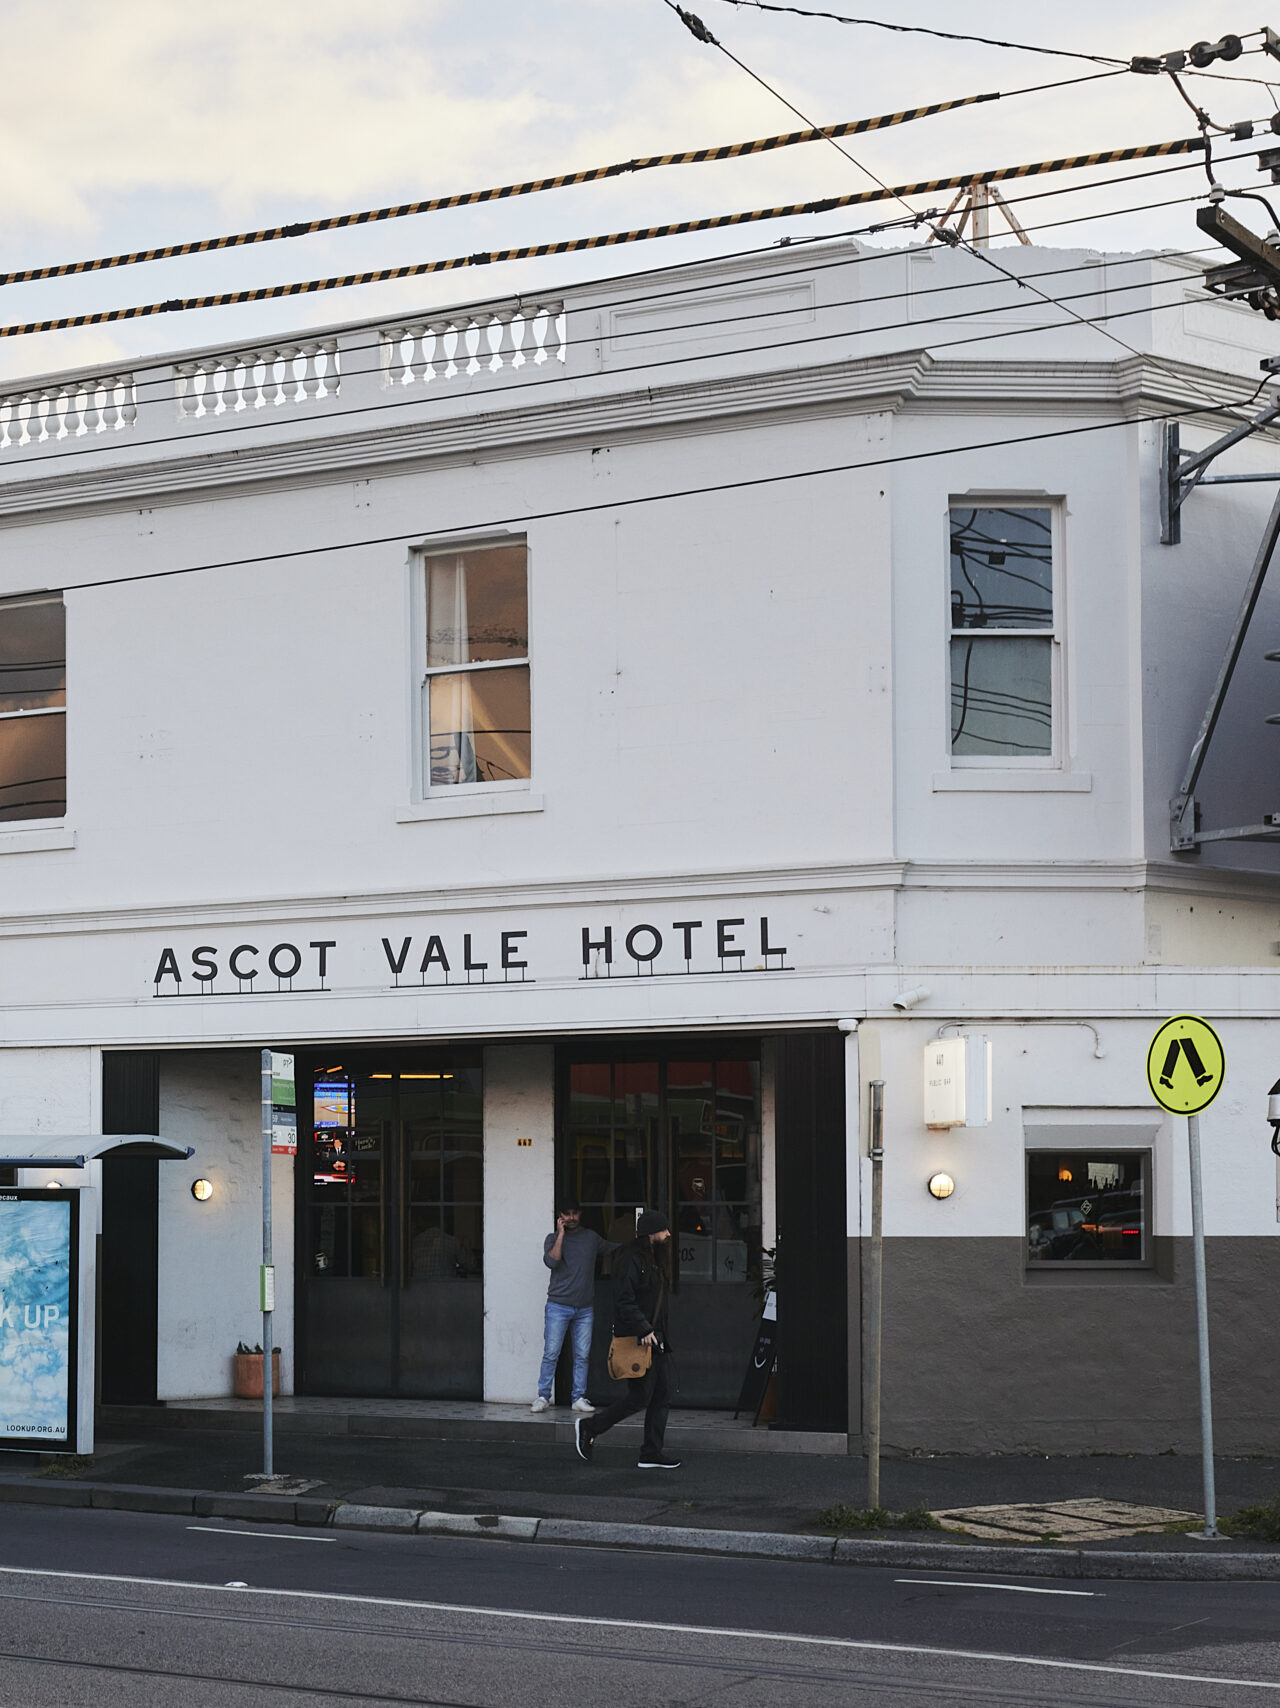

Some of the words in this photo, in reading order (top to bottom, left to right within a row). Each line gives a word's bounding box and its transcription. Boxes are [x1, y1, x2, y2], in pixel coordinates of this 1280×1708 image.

[153, 941, 336, 984] ASCOT
[381, 930, 528, 974] VALE
[581, 916, 788, 966] HOTEL
[287, 1132, 296, 1144] 30
[23, 1304, 60, 1329] UP
[6, 1424, 66, 1434] LOOKUP.ORG.AU
